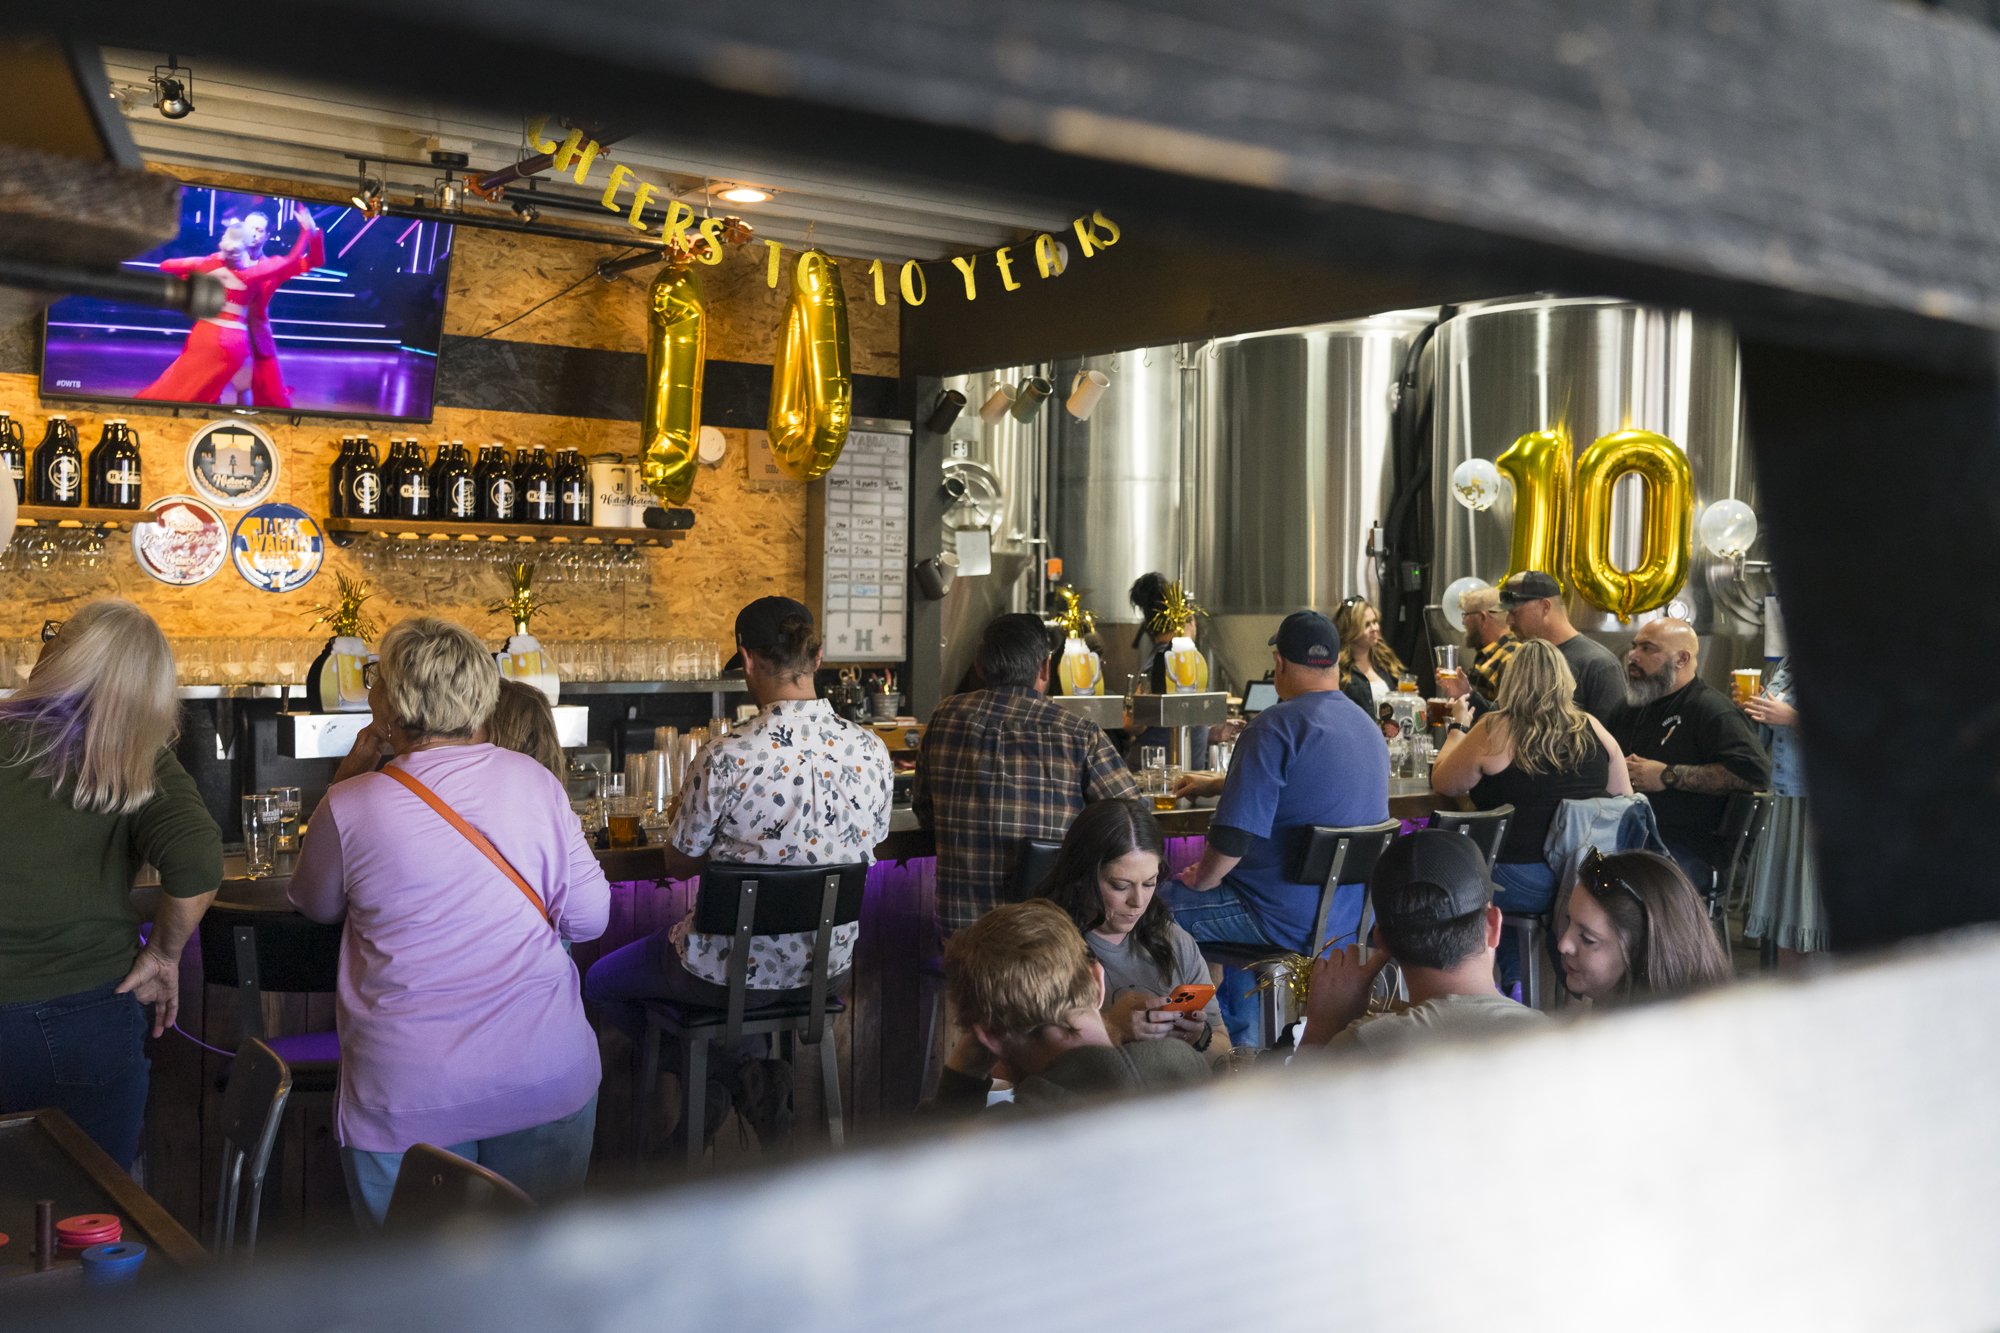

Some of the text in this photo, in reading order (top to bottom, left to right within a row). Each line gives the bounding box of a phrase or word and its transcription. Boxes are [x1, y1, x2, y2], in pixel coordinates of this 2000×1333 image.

[528, 114, 1121, 306] CHEERS TO 10 YEARS
[56, 380, 81, 388] #DWTS
[1496, 428, 1695, 624] 10
[854, 629, 873, 651] H
